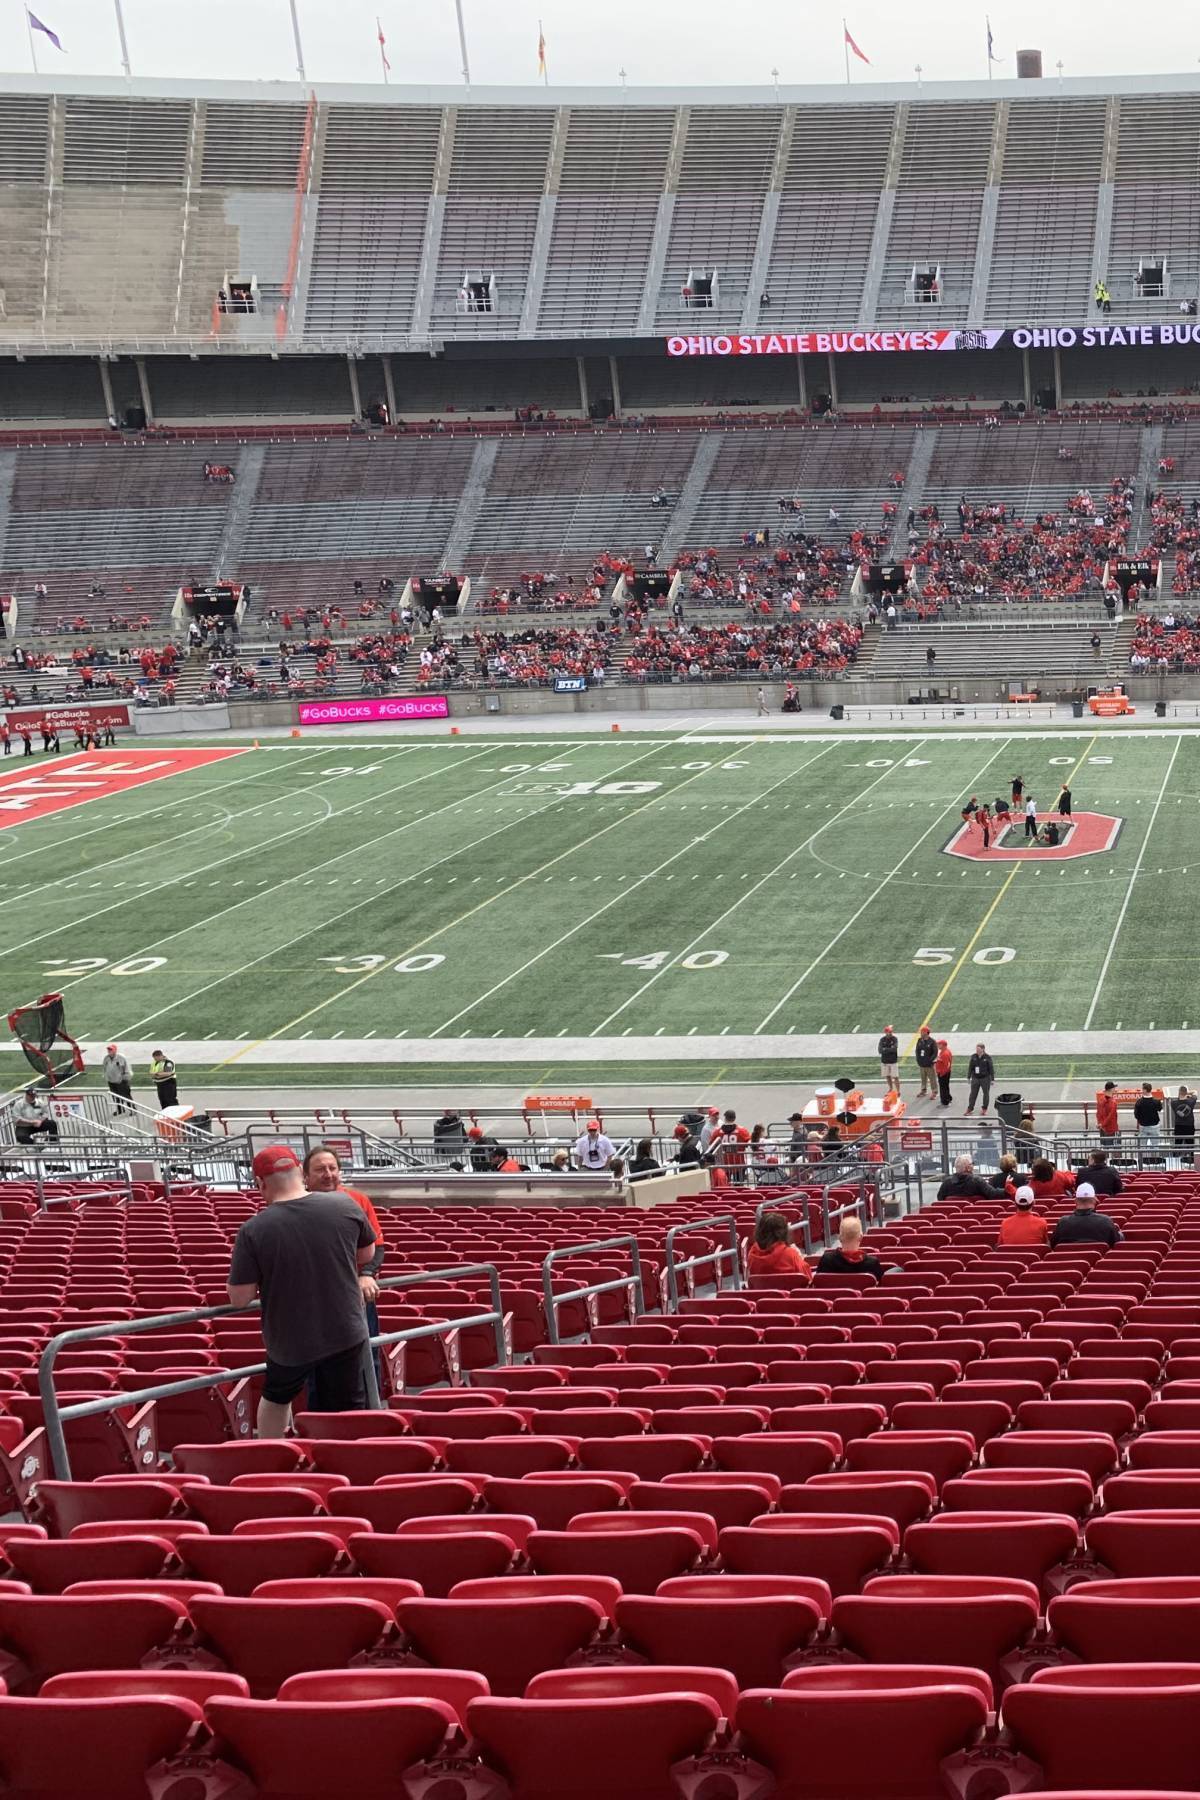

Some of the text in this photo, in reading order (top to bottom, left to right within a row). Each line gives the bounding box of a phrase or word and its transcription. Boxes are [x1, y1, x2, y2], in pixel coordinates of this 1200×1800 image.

[667, 331, 938, 356] OHIO STATE BUCKEYES
[1013, 328, 1077, 348] OHIO
[1082, 326, 1154, 346] STATE
[1117, 562, 1129, 570] Elk
[558, 680, 581, 689] BTN
[46, 710, 90, 719] #GoBucks
[334, 953, 447, 973] 30
[621, 950, 730, 970] 40
[911, 946, 1017, 966] 50
[42, 957, 168, 976] 20
